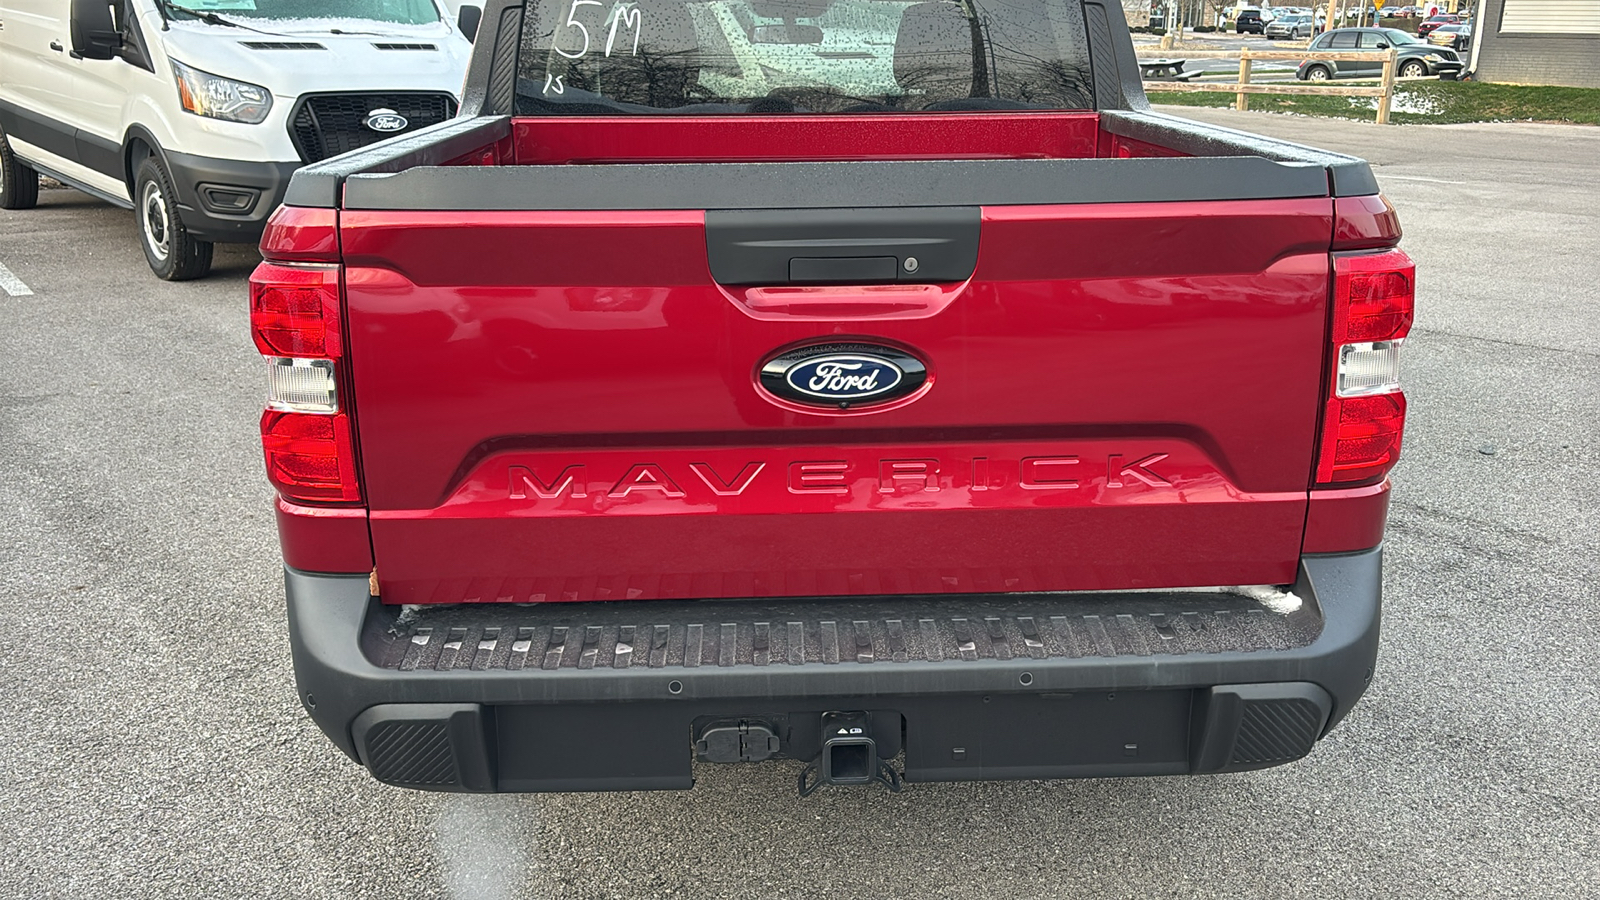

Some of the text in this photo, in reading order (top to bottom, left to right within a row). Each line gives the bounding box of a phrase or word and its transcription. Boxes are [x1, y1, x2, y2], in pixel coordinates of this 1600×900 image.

[375, 117, 400, 128] Ford
[808, 362, 880, 391] Ford
[508, 453, 1172, 499] MAVERICK
